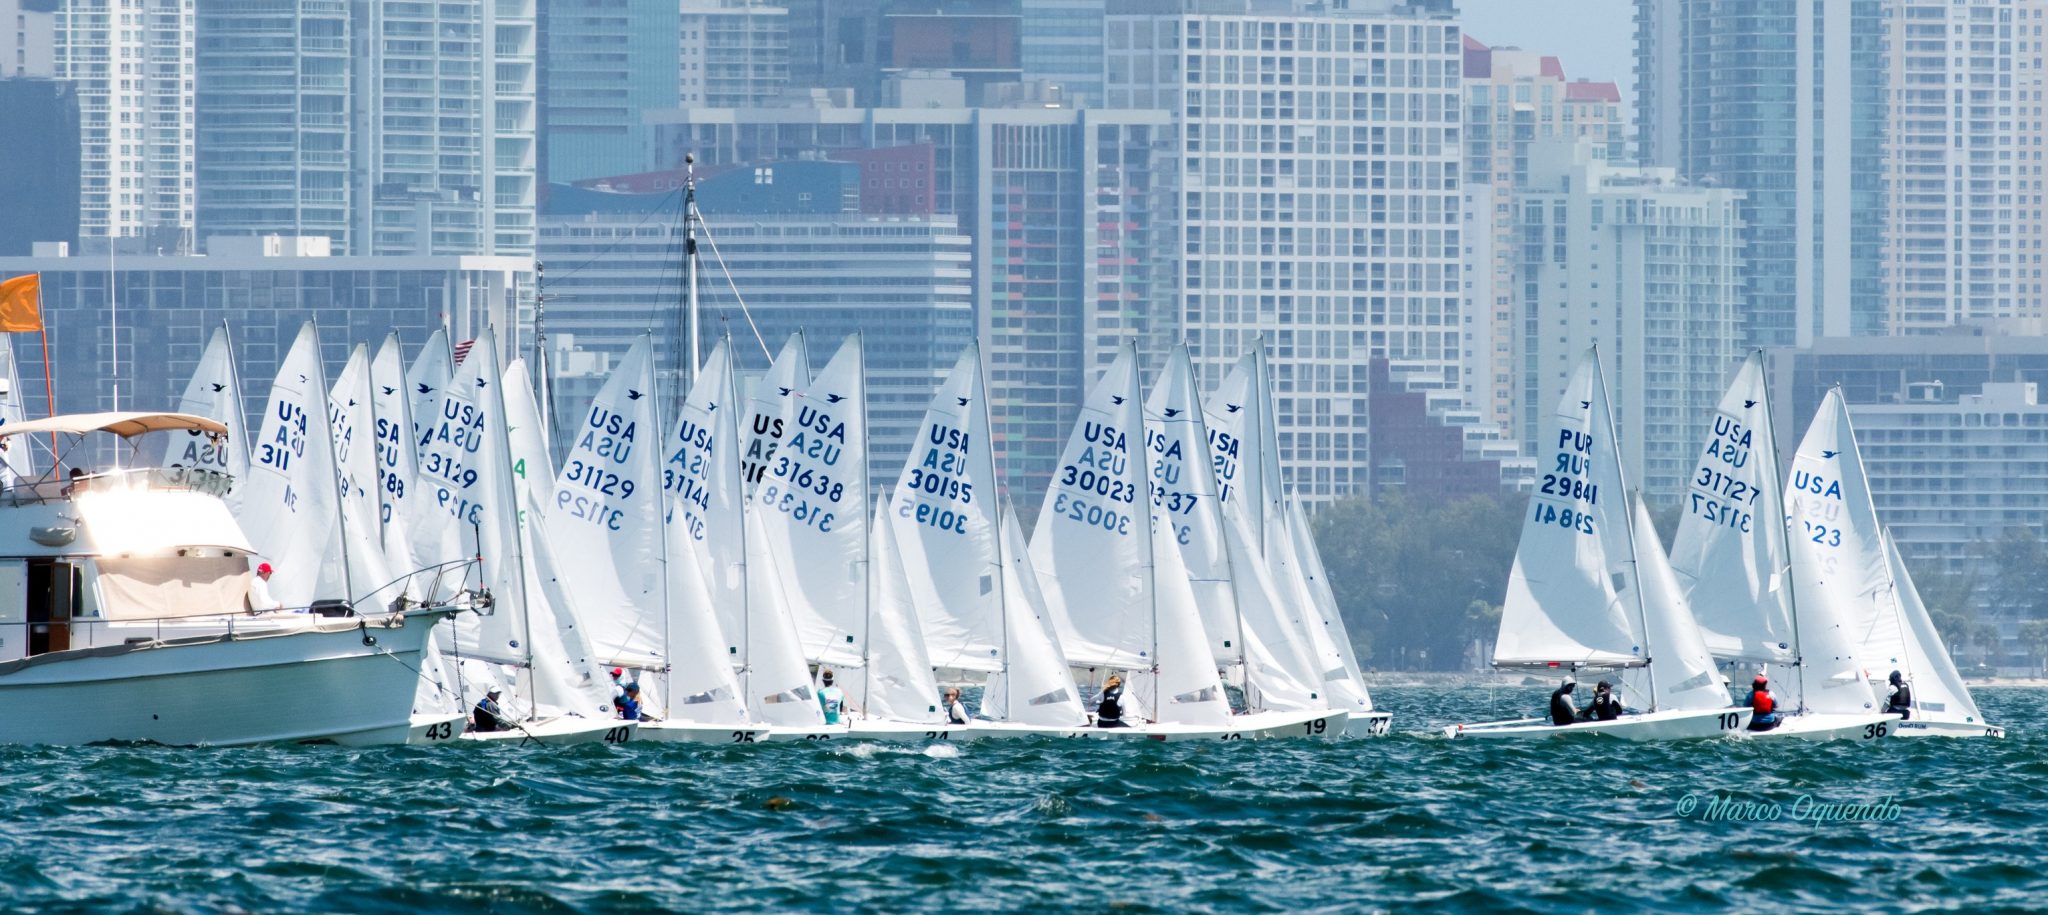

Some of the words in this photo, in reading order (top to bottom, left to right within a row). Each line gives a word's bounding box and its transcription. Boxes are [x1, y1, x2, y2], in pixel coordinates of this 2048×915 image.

[377, 418, 399, 445] SA
[444, 398, 485, 432] USA
[590, 406, 636, 443] USA
[753, 413, 784, 439] US
[798, 405, 845, 445] USA
[679, 420, 713, 458] USA
[930, 423, 970, 455] USA
[1084, 421, 1127, 454] USA
[1559, 429, 1593, 455] PUR
[1714, 415, 1752, 449] USA
[566, 460, 635, 500] 31129
[663, 469, 710, 512] 31144
[773, 456, 844, 503] 31638
[907, 468, 973, 504] 30195
[1061, 465, 1136, 504] 30023
[1541, 474, 1598, 505] 29841
[1697, 467, 1761, 506] 31727
[1794, 469, 1842, 500] USA
[425, 721, 452, 741] 43
[604, 726, 630, 744] 40
[1303, 717, 1327, 735] 19
[1718, 712, 1740, 730] 10
[1863, 721, 1888, 740] 36
